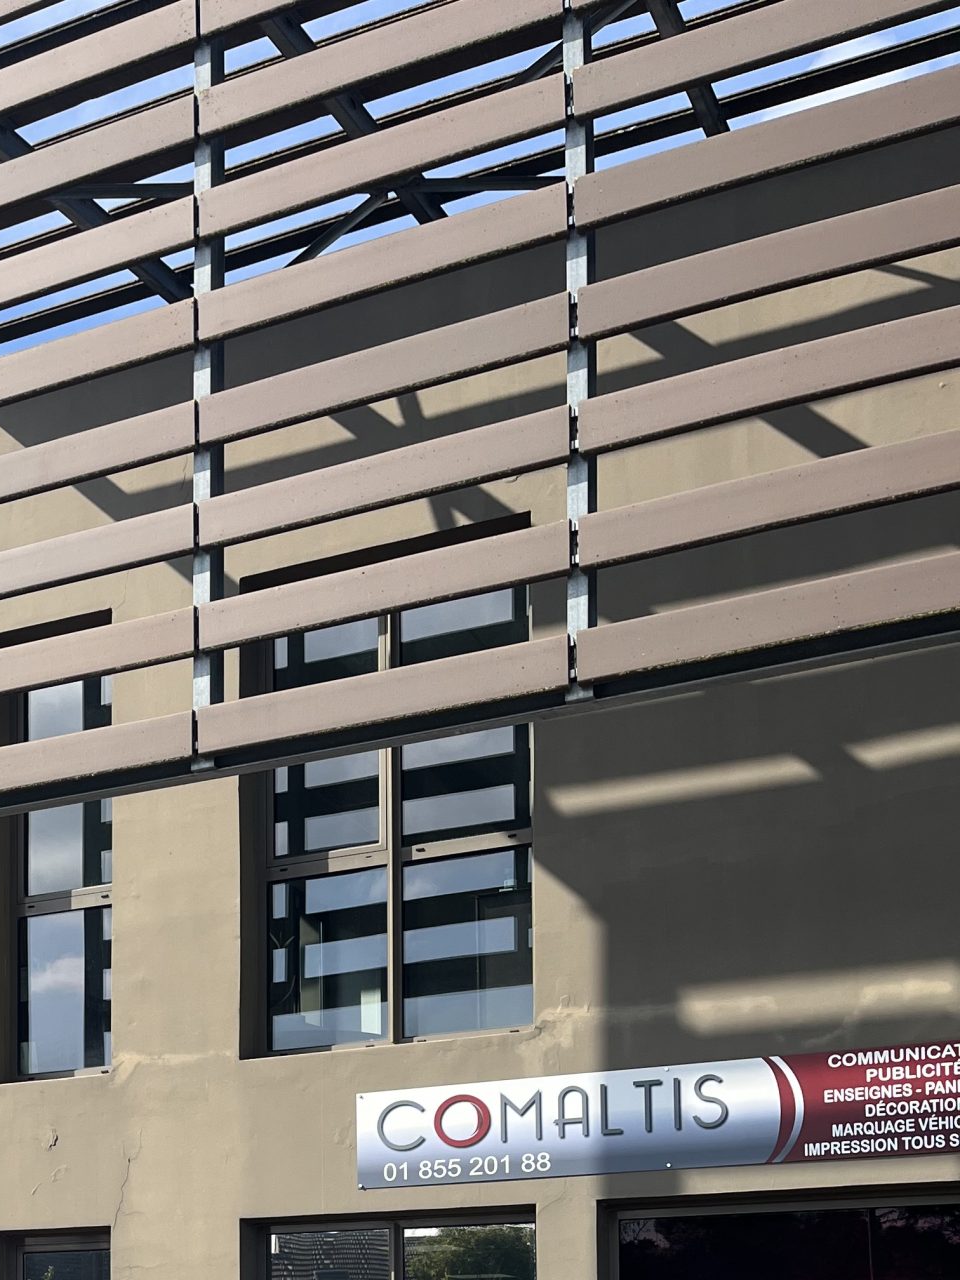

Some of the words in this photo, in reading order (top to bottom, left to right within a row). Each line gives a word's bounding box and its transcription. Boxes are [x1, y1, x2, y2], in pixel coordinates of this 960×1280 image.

[824, 1084, 912, 1104] ENSEIGNES
[376, 1073, 729, 1152] COMALTIS
[832, 1118, 915, 1138] MARQUAGE
[805, 1139, 898, 1157] IMPRESSION
[902, 1135, 945, 1150] TOUS
[383, 1162, 409, 1182] 01
[419, 1157, 461, 1179] 855
[469, 1154, 511, 1176] 201
[521, 1151, 551, 1173] 88
